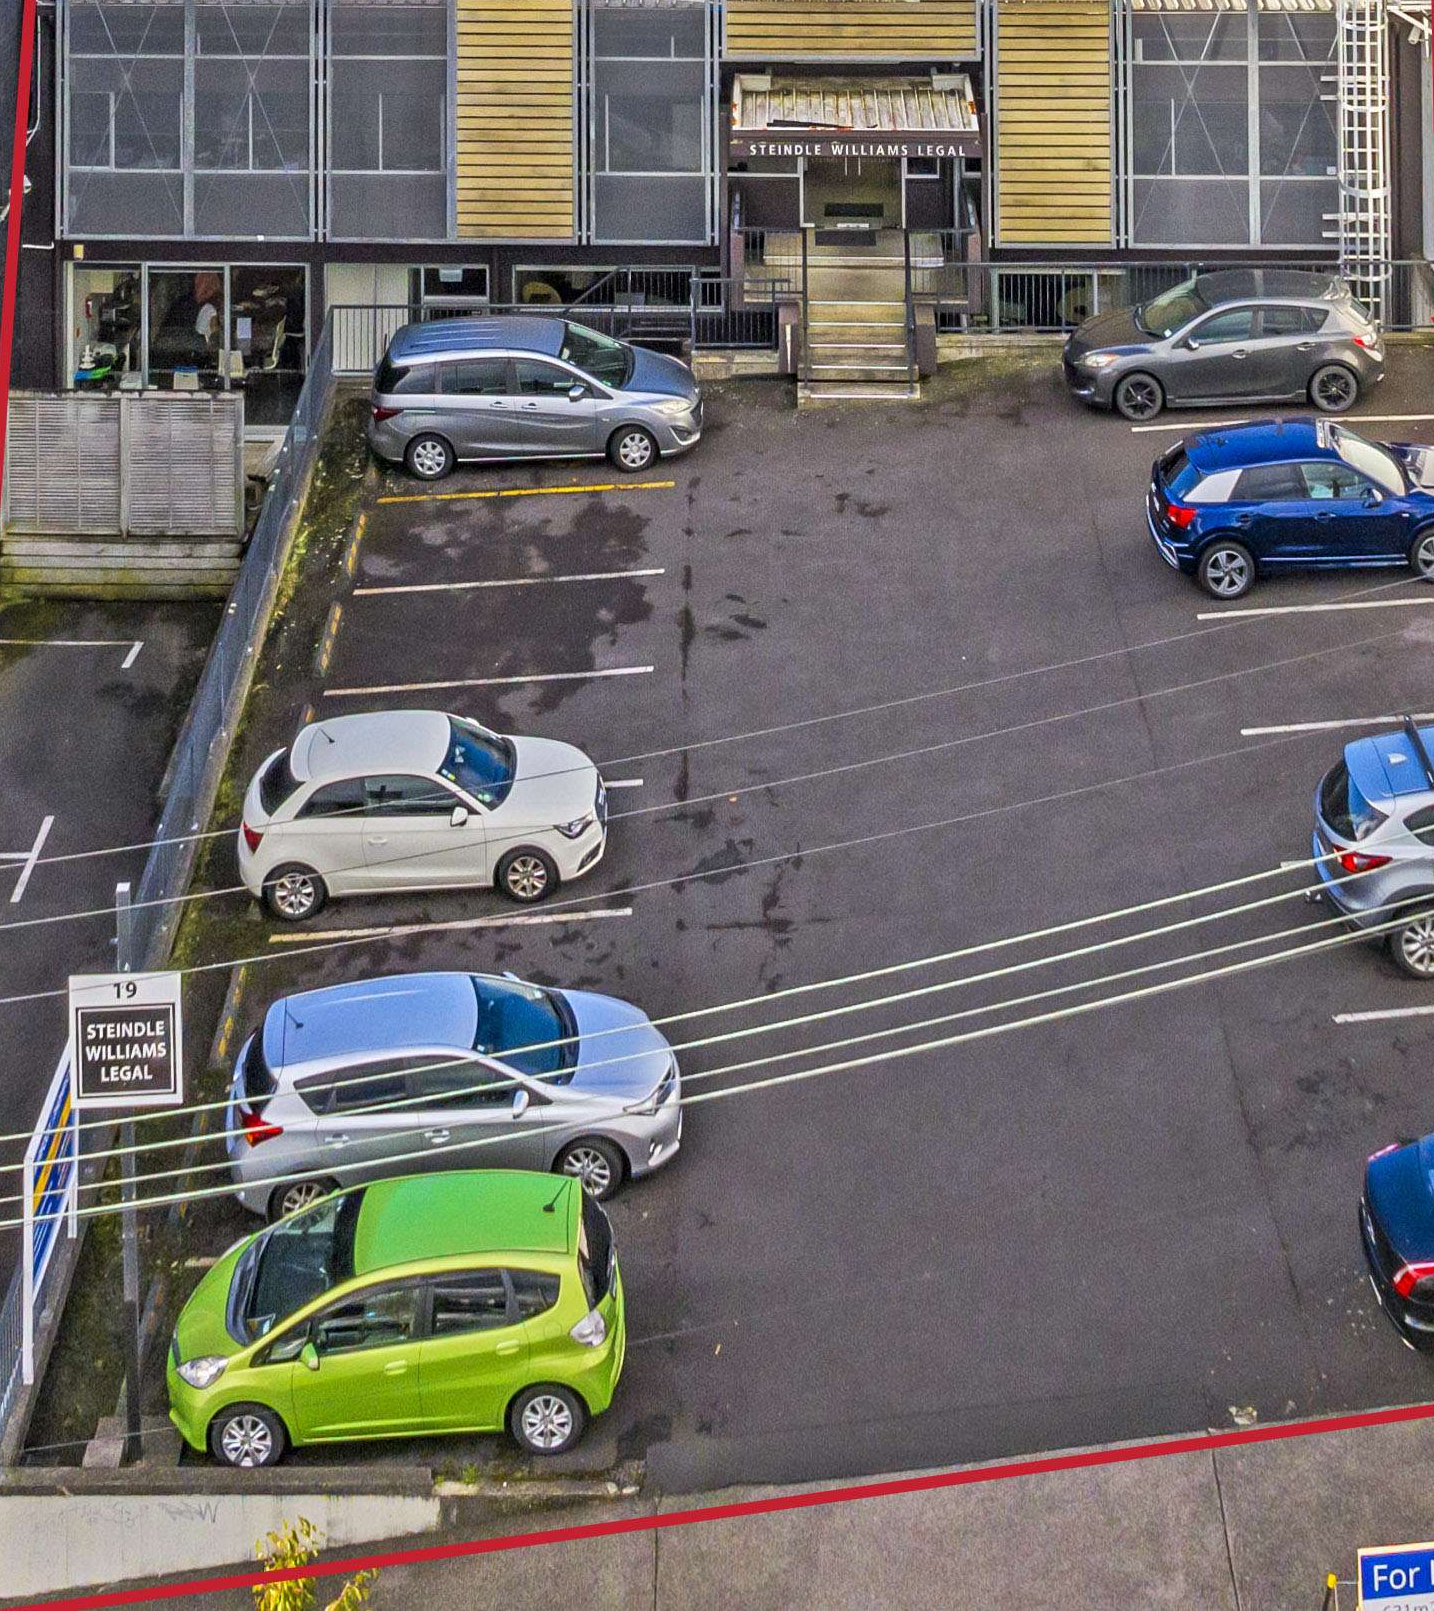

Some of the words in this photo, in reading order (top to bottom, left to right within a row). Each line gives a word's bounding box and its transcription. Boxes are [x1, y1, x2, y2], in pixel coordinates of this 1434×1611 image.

[749, 144, 822, 156] STEINDLE
[831, 144, 908, 156] WILLIAMS
[918, 145, 966, 157] LEGAL
[113, 981, 138, 1000] 19
[86, 1020, 166, 1041] STEINDLE
[85, 1041, 167, 1063] WILLIAMS
[100, 1064, 154, 1083] LEGAL
[1372, 1563, 1421, 1593] For
